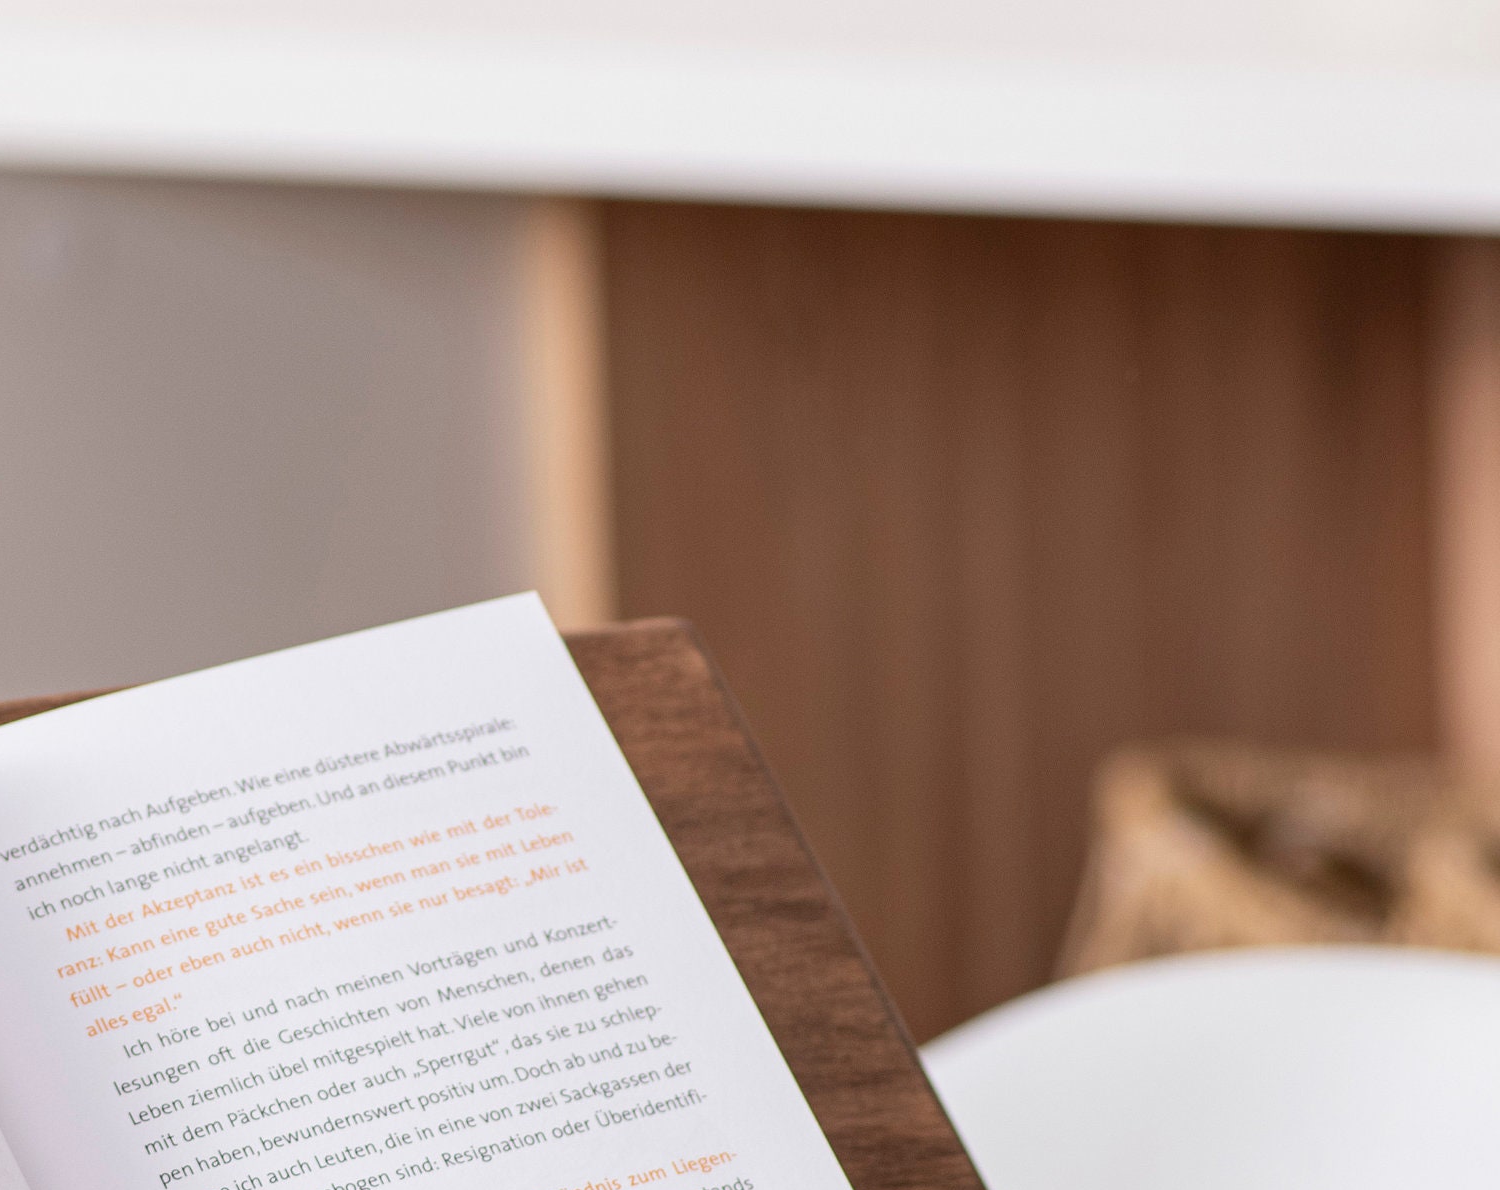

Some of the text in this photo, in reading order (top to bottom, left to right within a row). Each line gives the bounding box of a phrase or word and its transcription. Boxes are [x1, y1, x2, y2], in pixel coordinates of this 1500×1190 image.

[0, 718, 516, 862] verdächtig nach Aufgeben. Wie eine düstere Abwärtsspirale:
[66, 803, 557, 941] Mit der Akzeptanz ist es ein bisschen wie mit der Tole-
[87, 993, 182, 1037] alles egal.“
[123, 916, 617, 1058] Ich höre bei und nach meinen Vorträgen und Konzert-
[128, 975, 648, 1125] Leben ziemlich übel mitgespielt hat. Viele von ihnen gehen
[396, 1157, 439, 1180] sind:
[441, 1132, 547, 1167] Resignation
[552, 1120, 590, 1139] oder
[595, 1089, 707, 1127] Überidentifi-
[628, 1168, 666, 1187] zum
[671, 1152, 736, 1175] Liegen-
